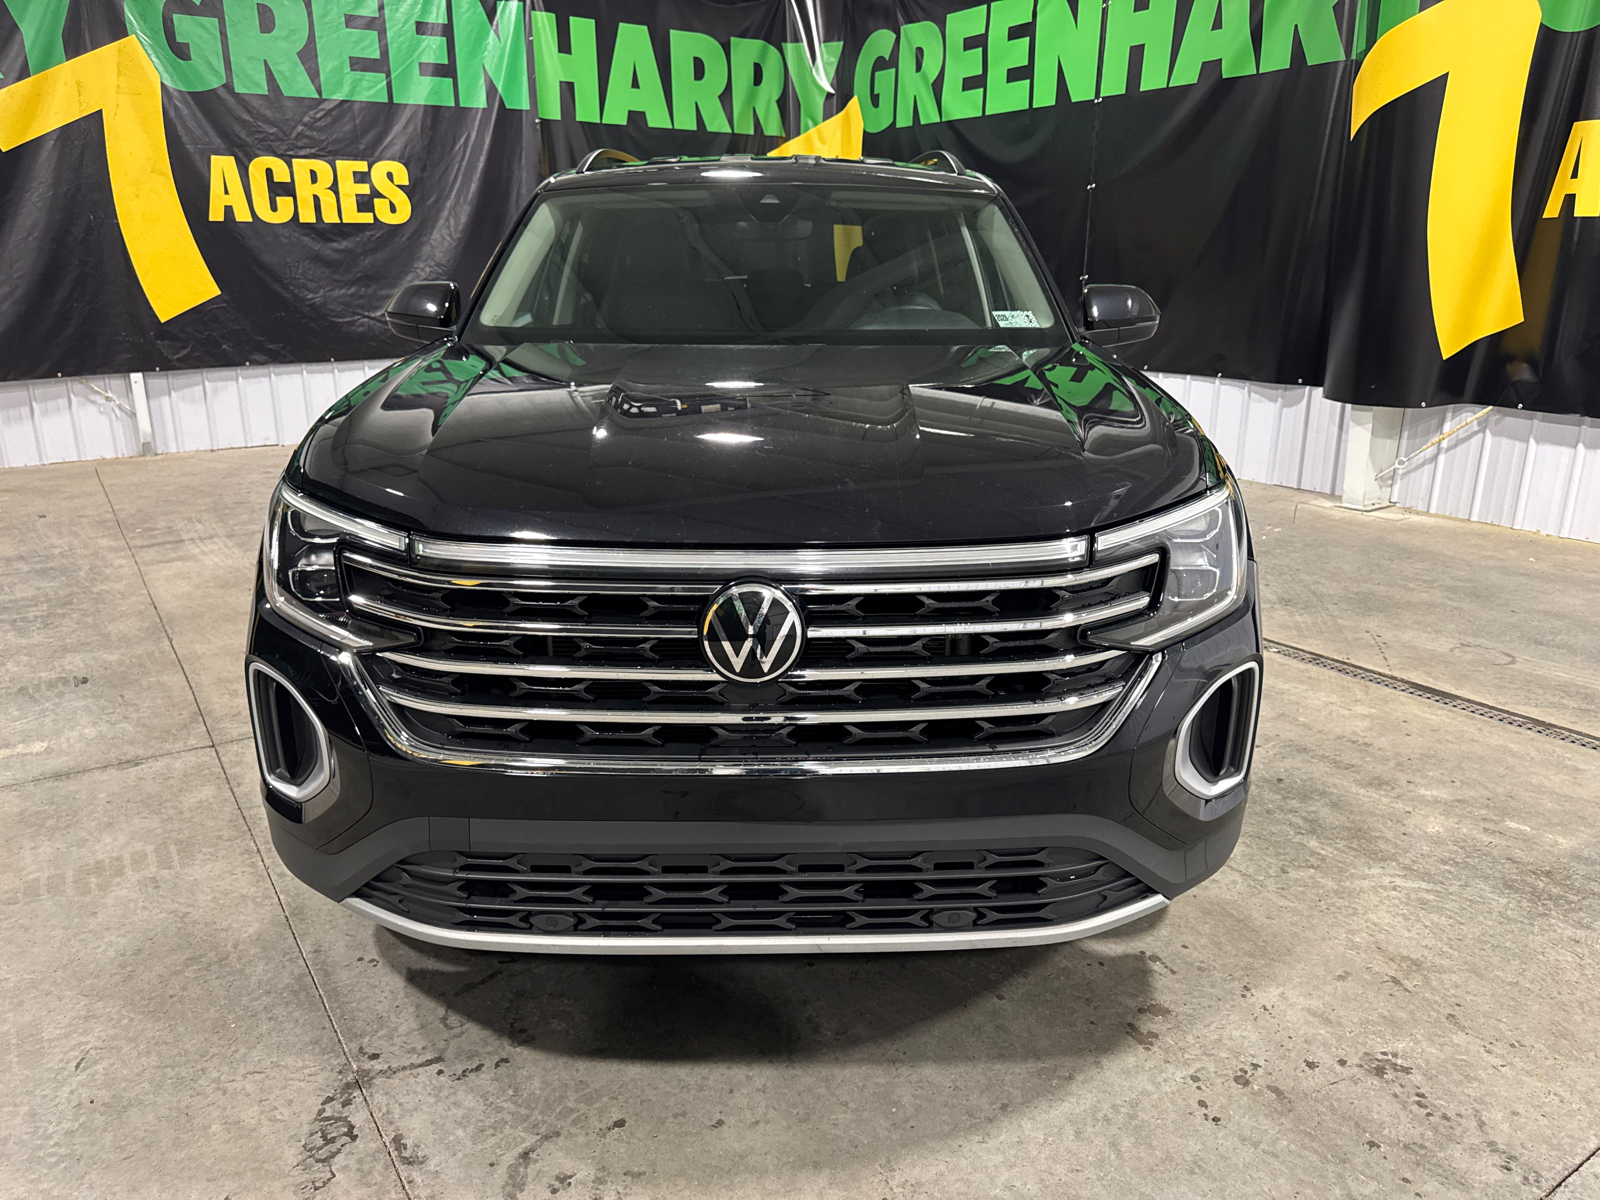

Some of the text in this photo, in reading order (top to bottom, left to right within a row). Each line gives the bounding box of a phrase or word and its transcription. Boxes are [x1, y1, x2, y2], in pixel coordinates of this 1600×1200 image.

[124, 0, 530, 110] GREEN
[531, 11, 844, 137] HARRY
[853, 0, 1102, 134] GREEN
[208, 155, 412, 225] ACRES
